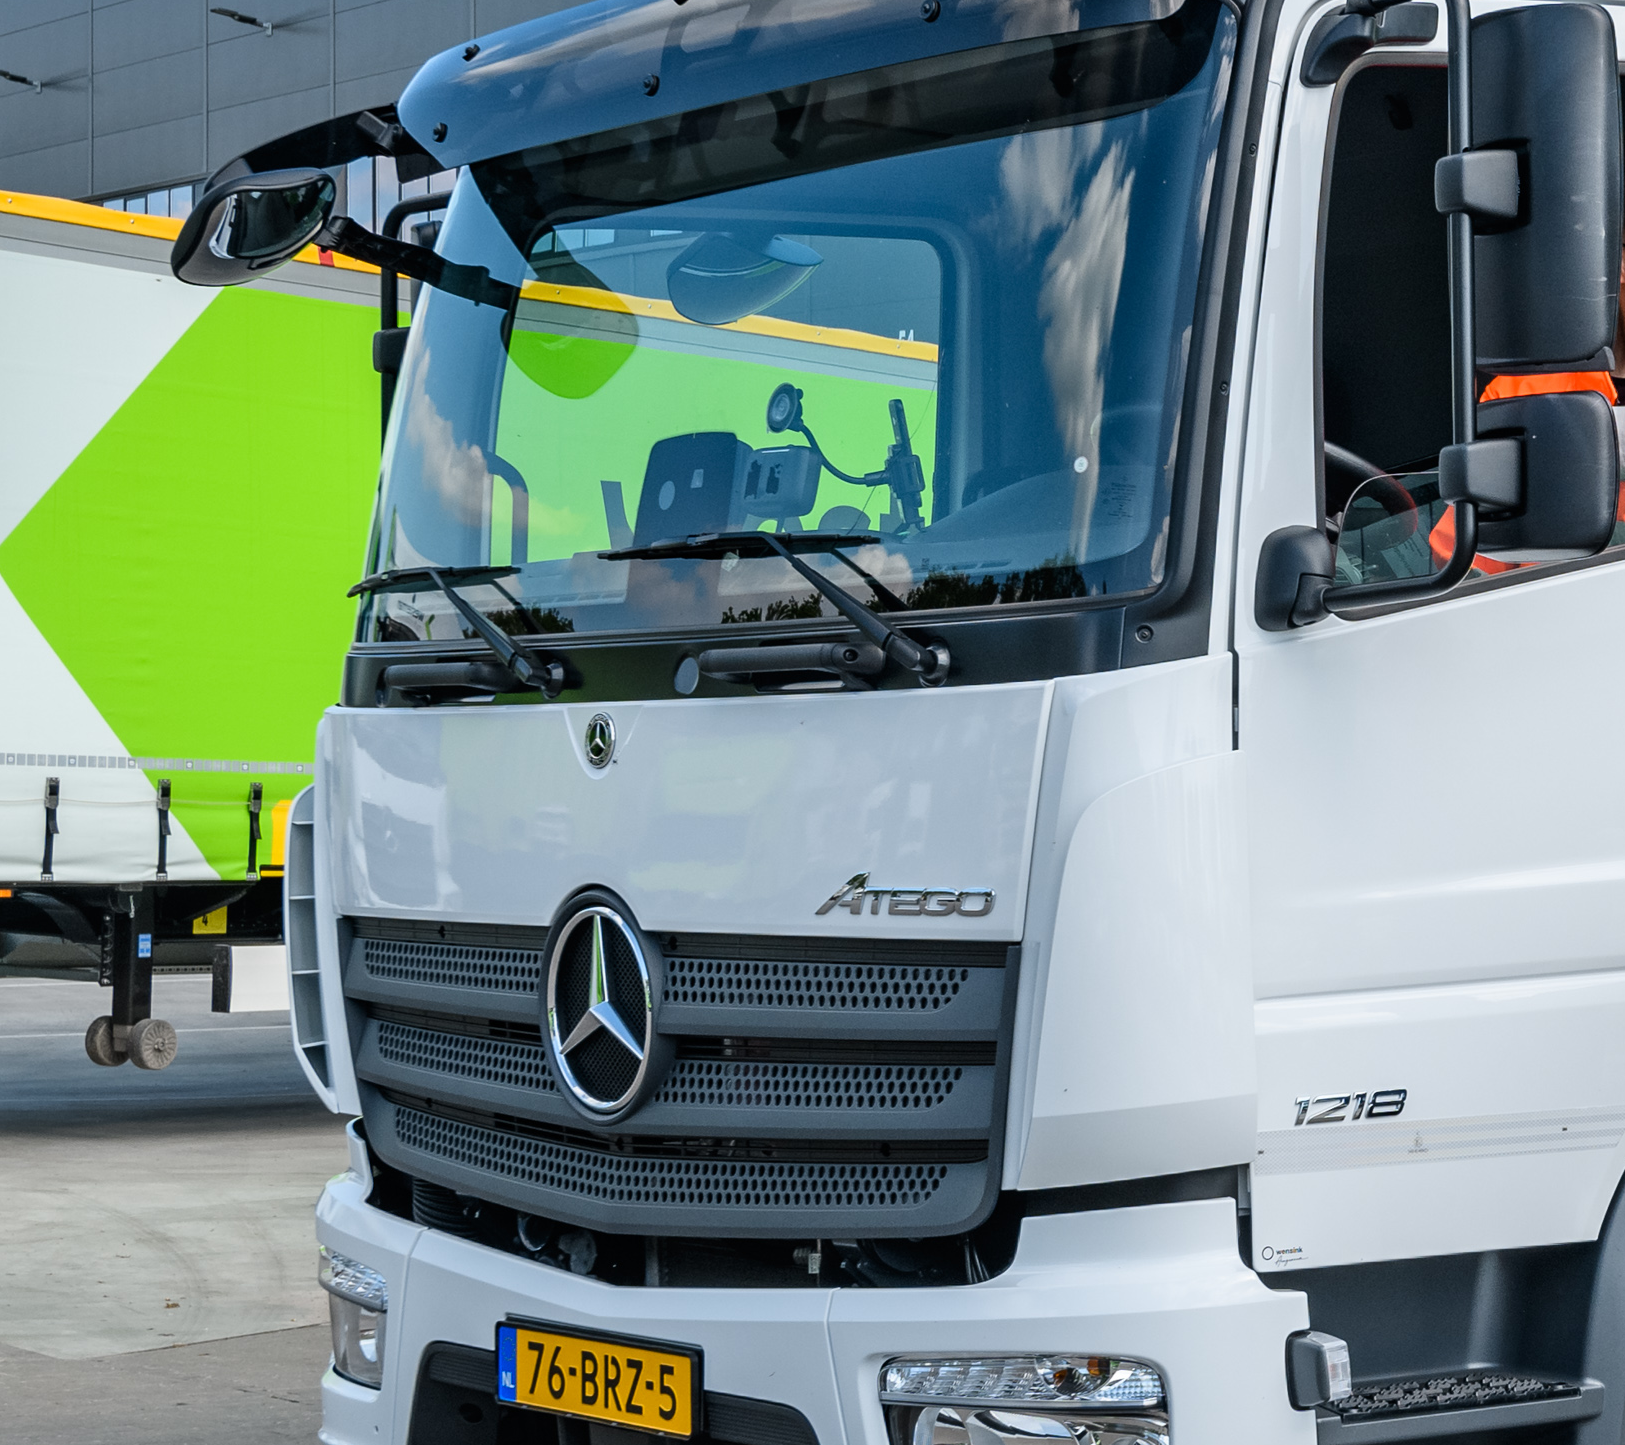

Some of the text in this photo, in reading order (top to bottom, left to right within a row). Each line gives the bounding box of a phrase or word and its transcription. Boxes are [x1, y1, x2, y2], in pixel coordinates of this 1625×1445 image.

[815, 871, 997, 917] ATEGO
[1294, 1088, 1408, 1127] 1218
[501, 1341, 677, 1421] NL 76-BRZ-5
